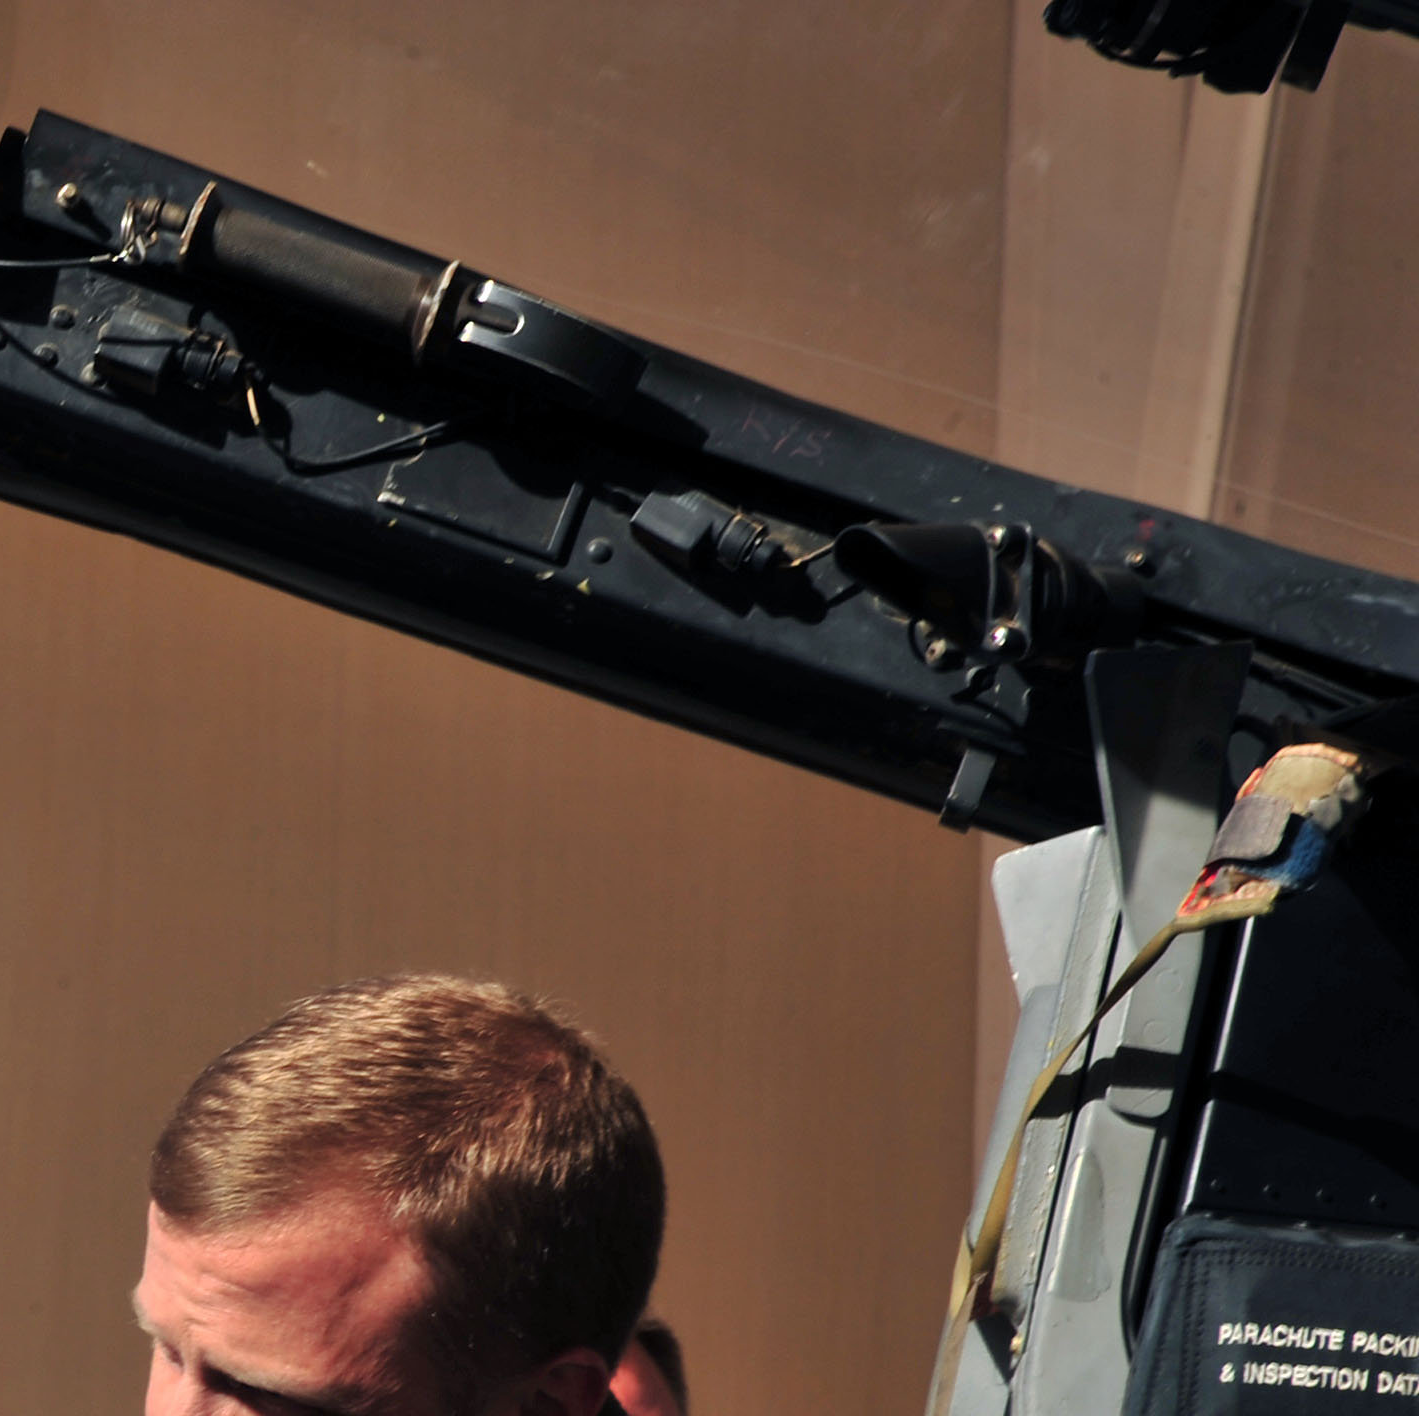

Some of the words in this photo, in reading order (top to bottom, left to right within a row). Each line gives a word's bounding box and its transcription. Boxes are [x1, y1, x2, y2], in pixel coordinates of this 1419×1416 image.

[1218, 1322, 1345, 1352] PARACHUTE
[1351, 1330, 1419, 1358] PACKI
[1219, 1362, 1236, 1383] &
[1243, 1361, 1370, 1391] INSPECTION
